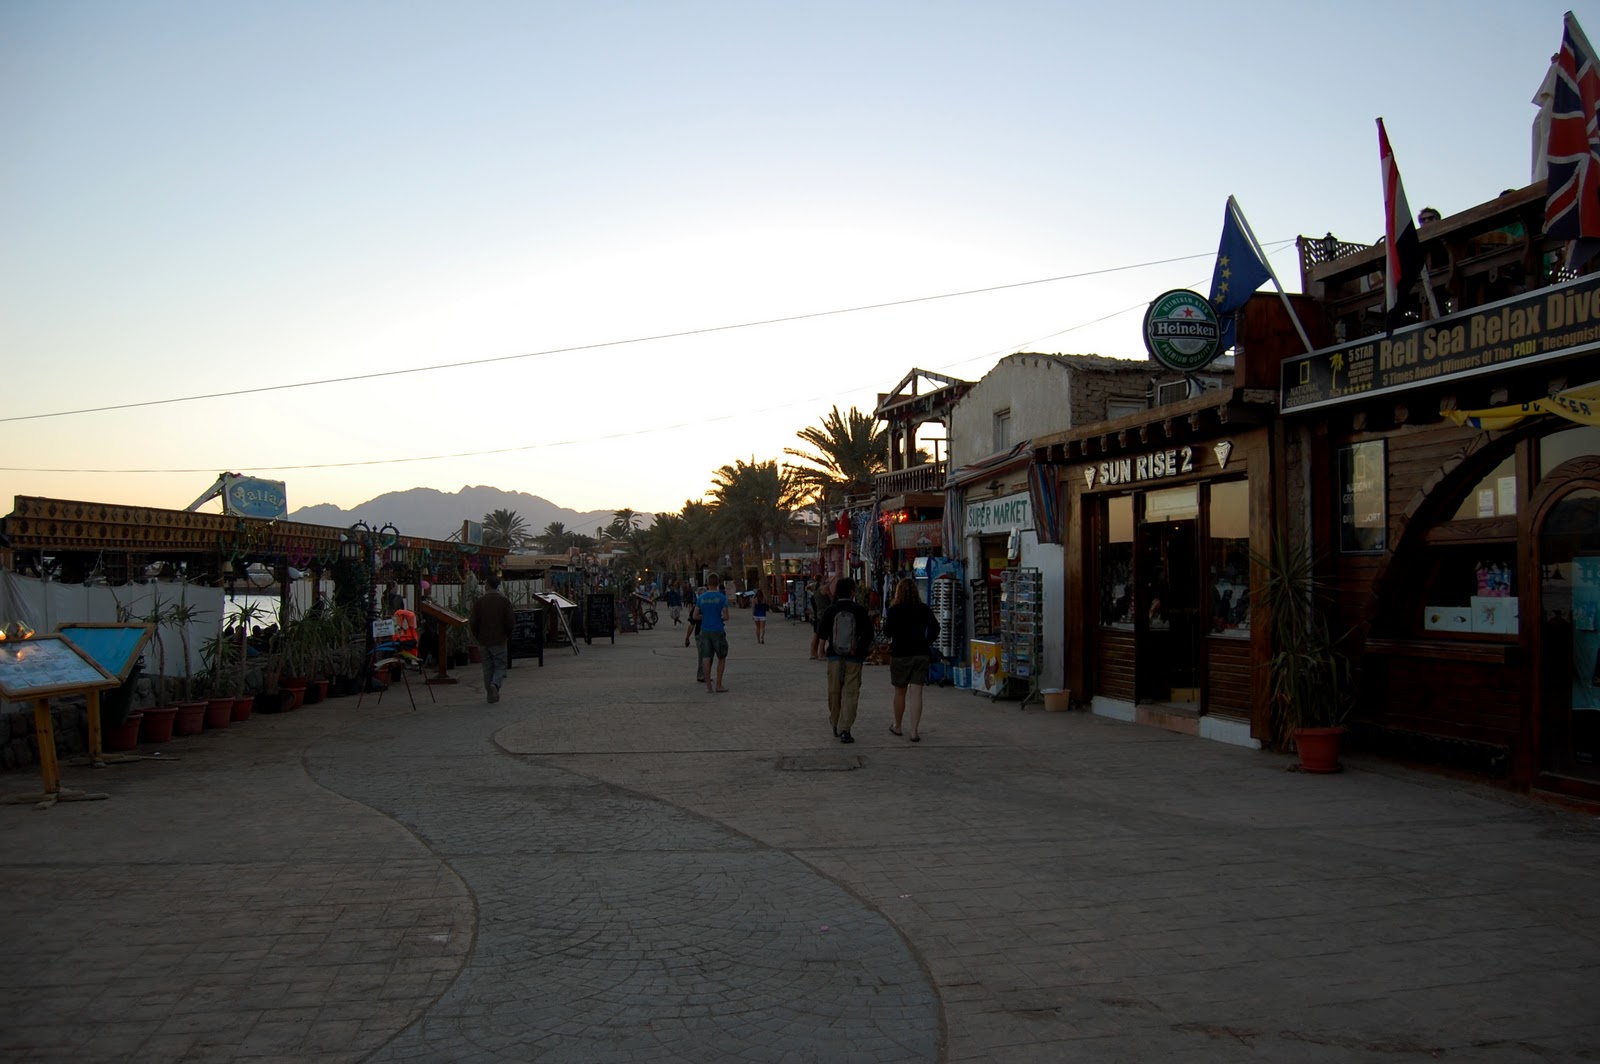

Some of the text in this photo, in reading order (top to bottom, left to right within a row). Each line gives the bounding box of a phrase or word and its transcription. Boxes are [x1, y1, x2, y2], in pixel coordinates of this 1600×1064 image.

[1157, 322, 1214, 336] Heineken
[1380, 332, 1418, 370] Red
[1424, 324, 1464, 360] Sea
[1470, 304, 1540, 349] Relax
[1161, 343, 1211, 364] PREMIUM QUALITY
[1348, 344, 1374, 362] 5 STAR
[1382, 374, 1389, 386] 5
[1389, 370, 1413, 385] Times
[1414, 363, 1441, 380] Award
[1442, 353, 1480, 373] Winners
[1482, 350, 1492, 365] Of
[1494, 346, 1512, 361] The
[1513, 340, 1536, 358] PADI
[1099, 446, 1193, 485] SUN RISE 2
[969, 500, 1027, 527] SUPER MARKET
